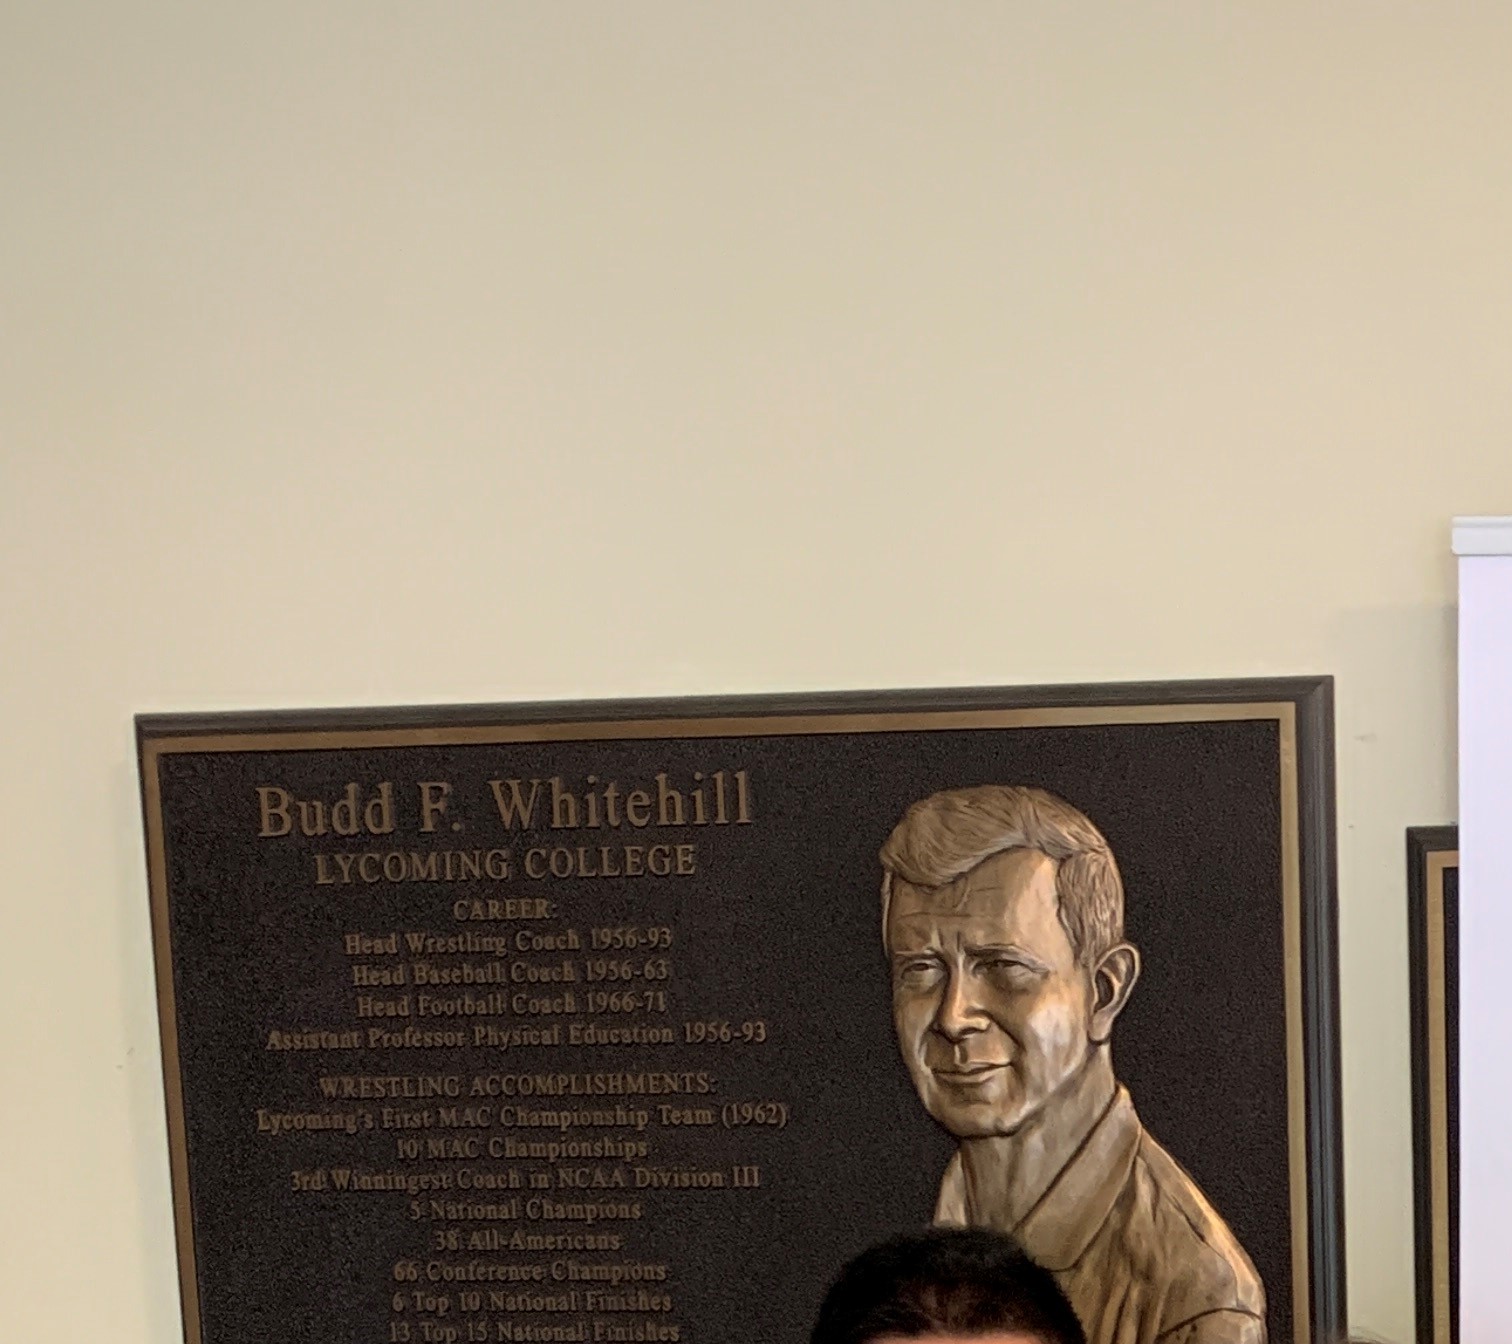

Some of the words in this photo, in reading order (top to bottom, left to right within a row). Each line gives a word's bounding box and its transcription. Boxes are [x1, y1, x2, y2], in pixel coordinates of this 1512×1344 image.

[256, 781, 394, 838] Budd
[417, 781, 462, 832] F.
[490, 771, 752, 830] Whitehill
[315, 849, 508, 884] LYCOMING
[525, 844, 697, 879] COLLEGE
[453, 898, 559, 920] CAREER:
[345, 934, 398, 954] Head
[405, 932, 507, 956] Wrestling
[515, 929, 579, 950] Coach
[591, 927, 672, 949] 1956-93
[353, 966, 405, 985] Head
[414, 963, 504, 984] Baseball
[511, 961, 575, 982] Coach
[585, 960, 668, 981] 1956-63
[357, 997, 409, 1017] Head
[418, 994, 505, 1015] Football
[512, 993, 575, 1013] Coach
[586, 992, 666, 1013] 1966-71
[266, 1029, 361, 1050] Assistant
[369, 1027, 465, 1048] Professor
[474, 1024, 559, 1050] Physical
[569, 1024, 674, 1045] Education
[683, 1022, 766, 1043] 1956-93
[319, 1076, 459, 1098] WRESTLING
[470, 1071, 717, 1096] ACCOMPLISHMENTS:
[256, 1109, 373, 1135] Lycoming's
[382, 1107, 430, 1128] First
[439, 1106, 490, 1127] MAC
[501, 1105, 648, 1131] Championship
[658, 1105, 713, 1125] Team
[721, 1103, 787, 1128] (1962)
[398, 1139, 418, 1158] 10
[427, 1138, 479, 1158] MAC
[488, 1136, 647, 1161] Championships
[291, 1171, 326, 1191] 3rd
[331, 1169, 451, 1194] Winningest
[457, 1169, 520, 1189] Coach
[530, 1169, 549, 1188] in
[557, 1168, 625, 1188] NCAA
[635, 1167, 725, 1187] Division
[732, 1166, 761, 1187] III
[410, 1201, 421, 1220] 5
[430, 1199, 518, 1220] National
[526, 1199, 642, 1224] Champions
[468, 1230, 620, 1250] All-Americans
[393, 1261, 418, 1281] 66
[426, 1261, 544, 1281] Conference
[551, 1260, 667, 1285] Champions
[412, 1291, 449, 1316] Top
[459, 1292, 480, 1311] 10
[490, 1291, 577, 1311] National
[586, 1291, 672, 1311] Finishes
[390, 1322, 410, 1342] 13
[420, 1322, 457, 1344] Top
[468, 1322, 488, 1340] 15
[497, 1322, 584, 1342] National
[593, 1321, 680, 1342] Finishes
